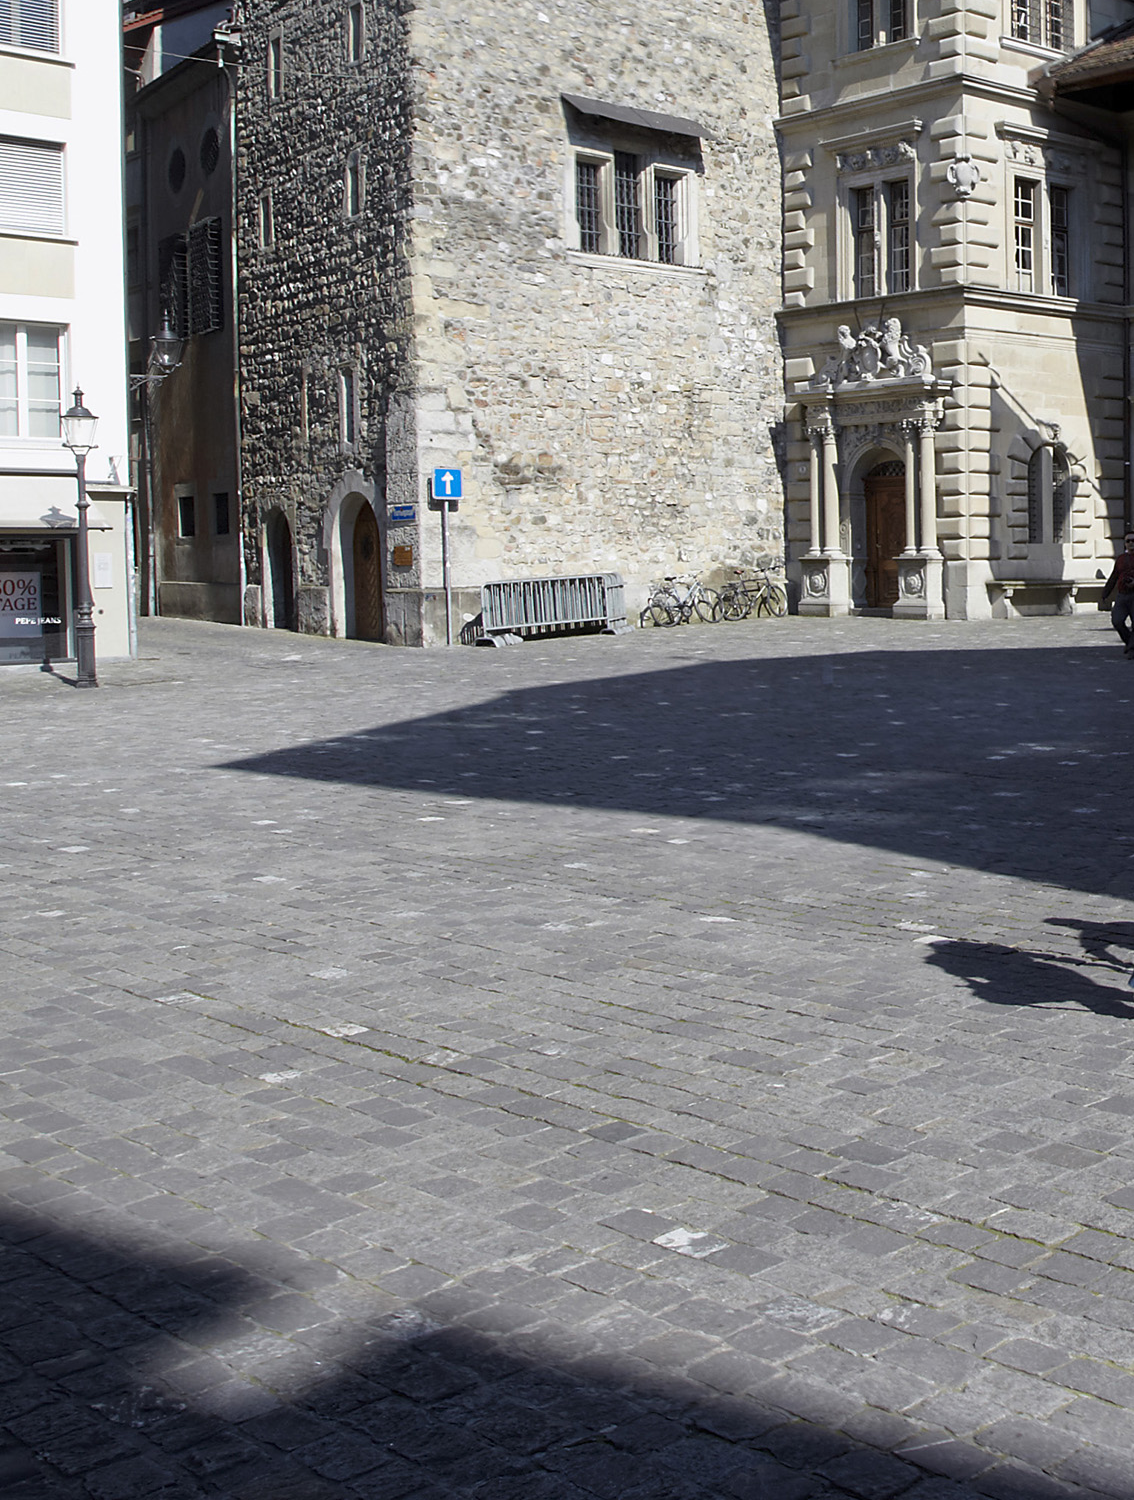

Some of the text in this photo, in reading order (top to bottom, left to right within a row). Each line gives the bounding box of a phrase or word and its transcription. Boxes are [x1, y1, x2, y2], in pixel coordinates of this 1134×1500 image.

[0, 578, 37, 596] 0%
[0, 597, 37, 612] AGE
[15, 617, 61, 625] PEPE JEANS
